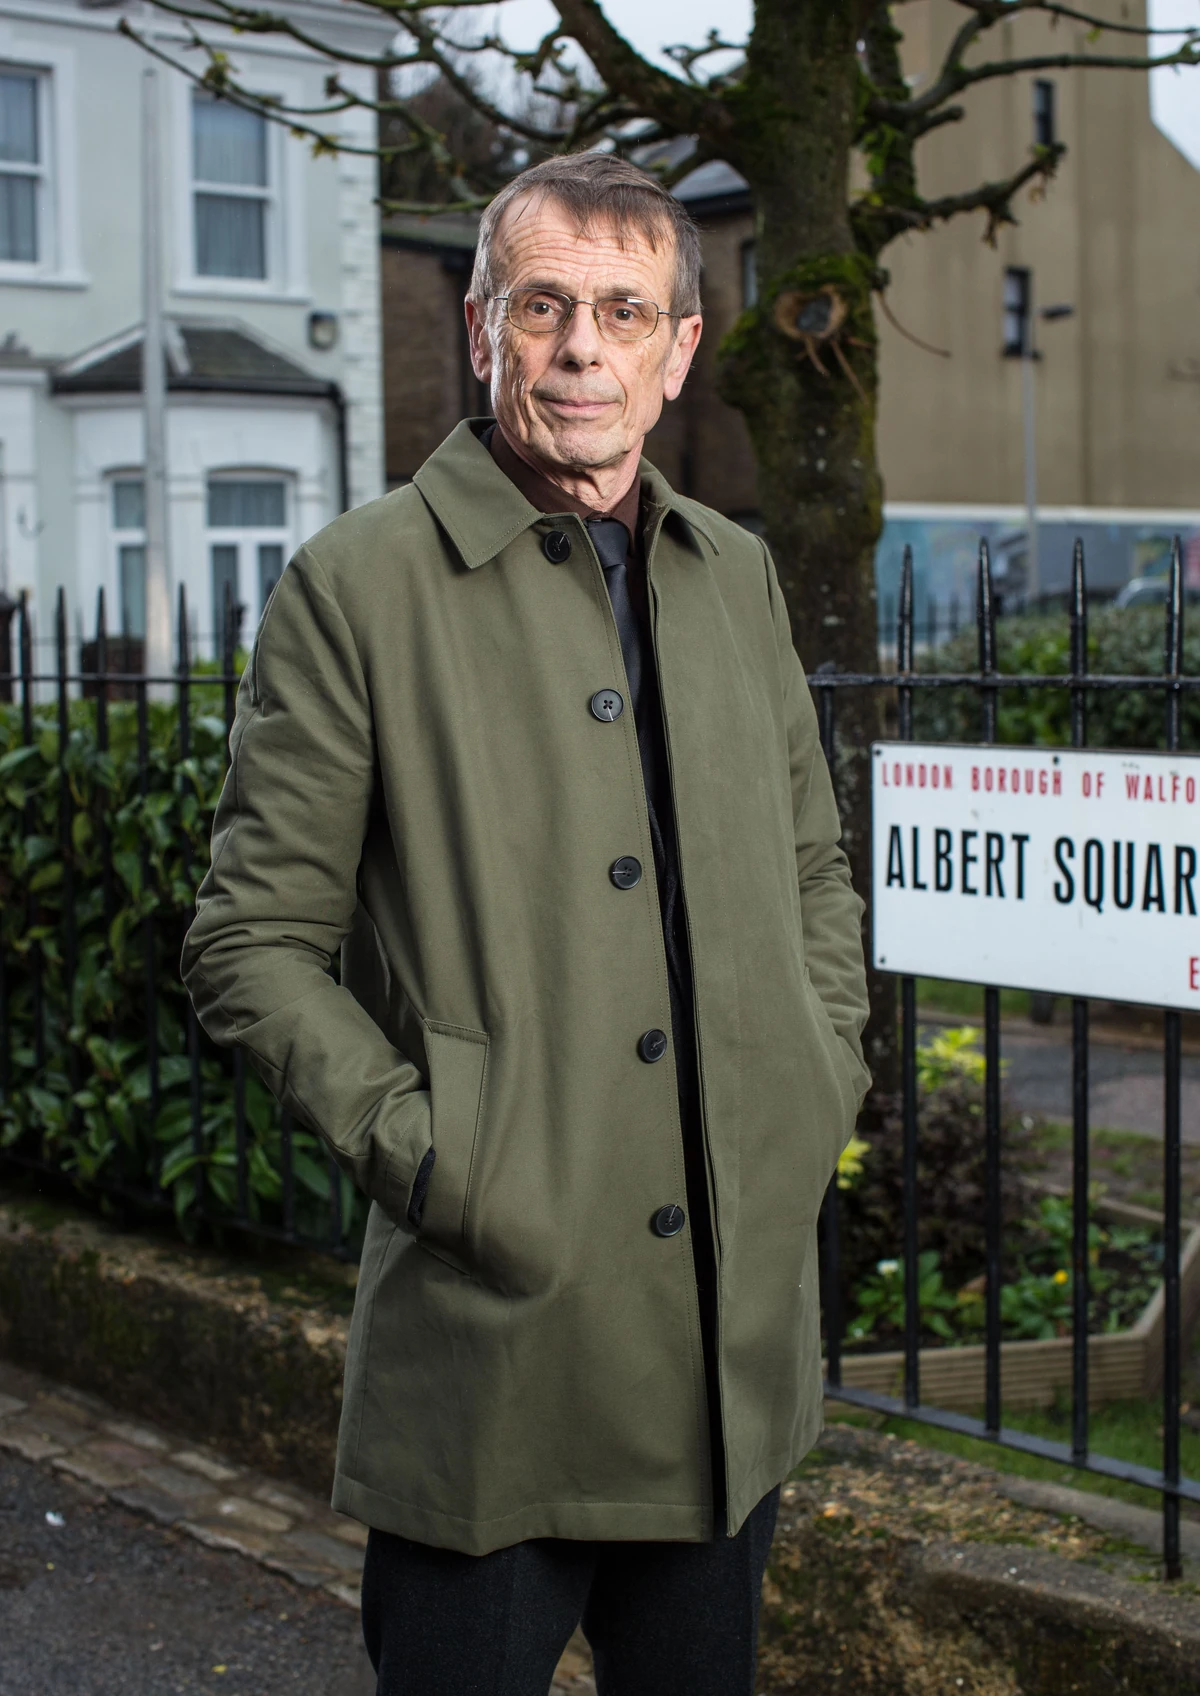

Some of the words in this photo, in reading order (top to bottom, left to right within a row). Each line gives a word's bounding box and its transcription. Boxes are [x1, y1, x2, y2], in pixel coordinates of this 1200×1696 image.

[882, 762, 953, 790] LONDON
[971, 766, 1062, 796] BOROUGH
[1082, 772, 1105, 798] OF
[885, 824, 1030, 900] ALBERT
